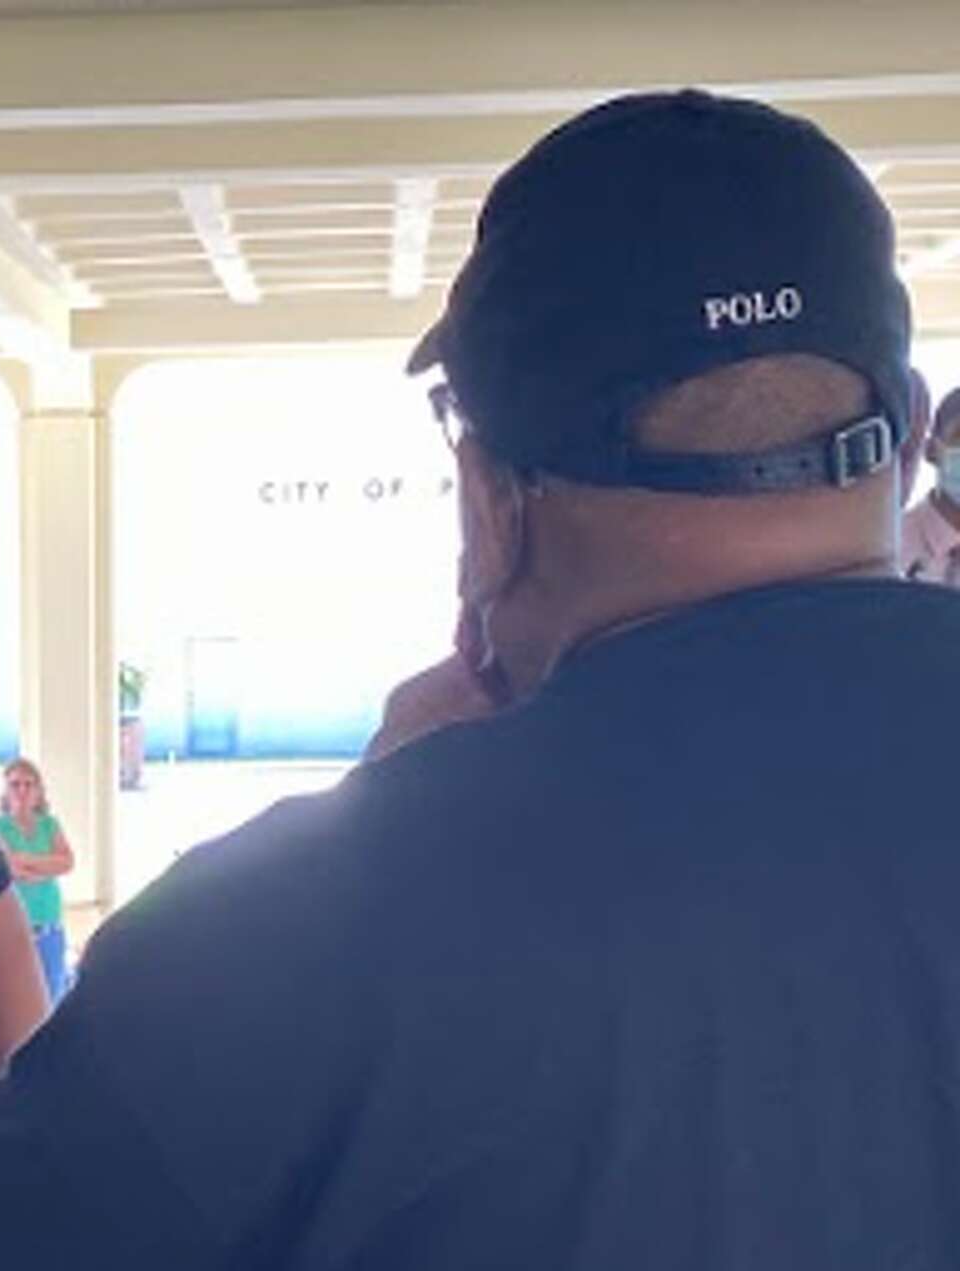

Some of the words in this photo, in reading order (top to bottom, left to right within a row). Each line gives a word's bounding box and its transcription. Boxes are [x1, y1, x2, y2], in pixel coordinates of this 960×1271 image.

[704, 287, 802, 330] POLO
[258, 480, 330, 504] CITY
[362, 477, 404, 501] OF
